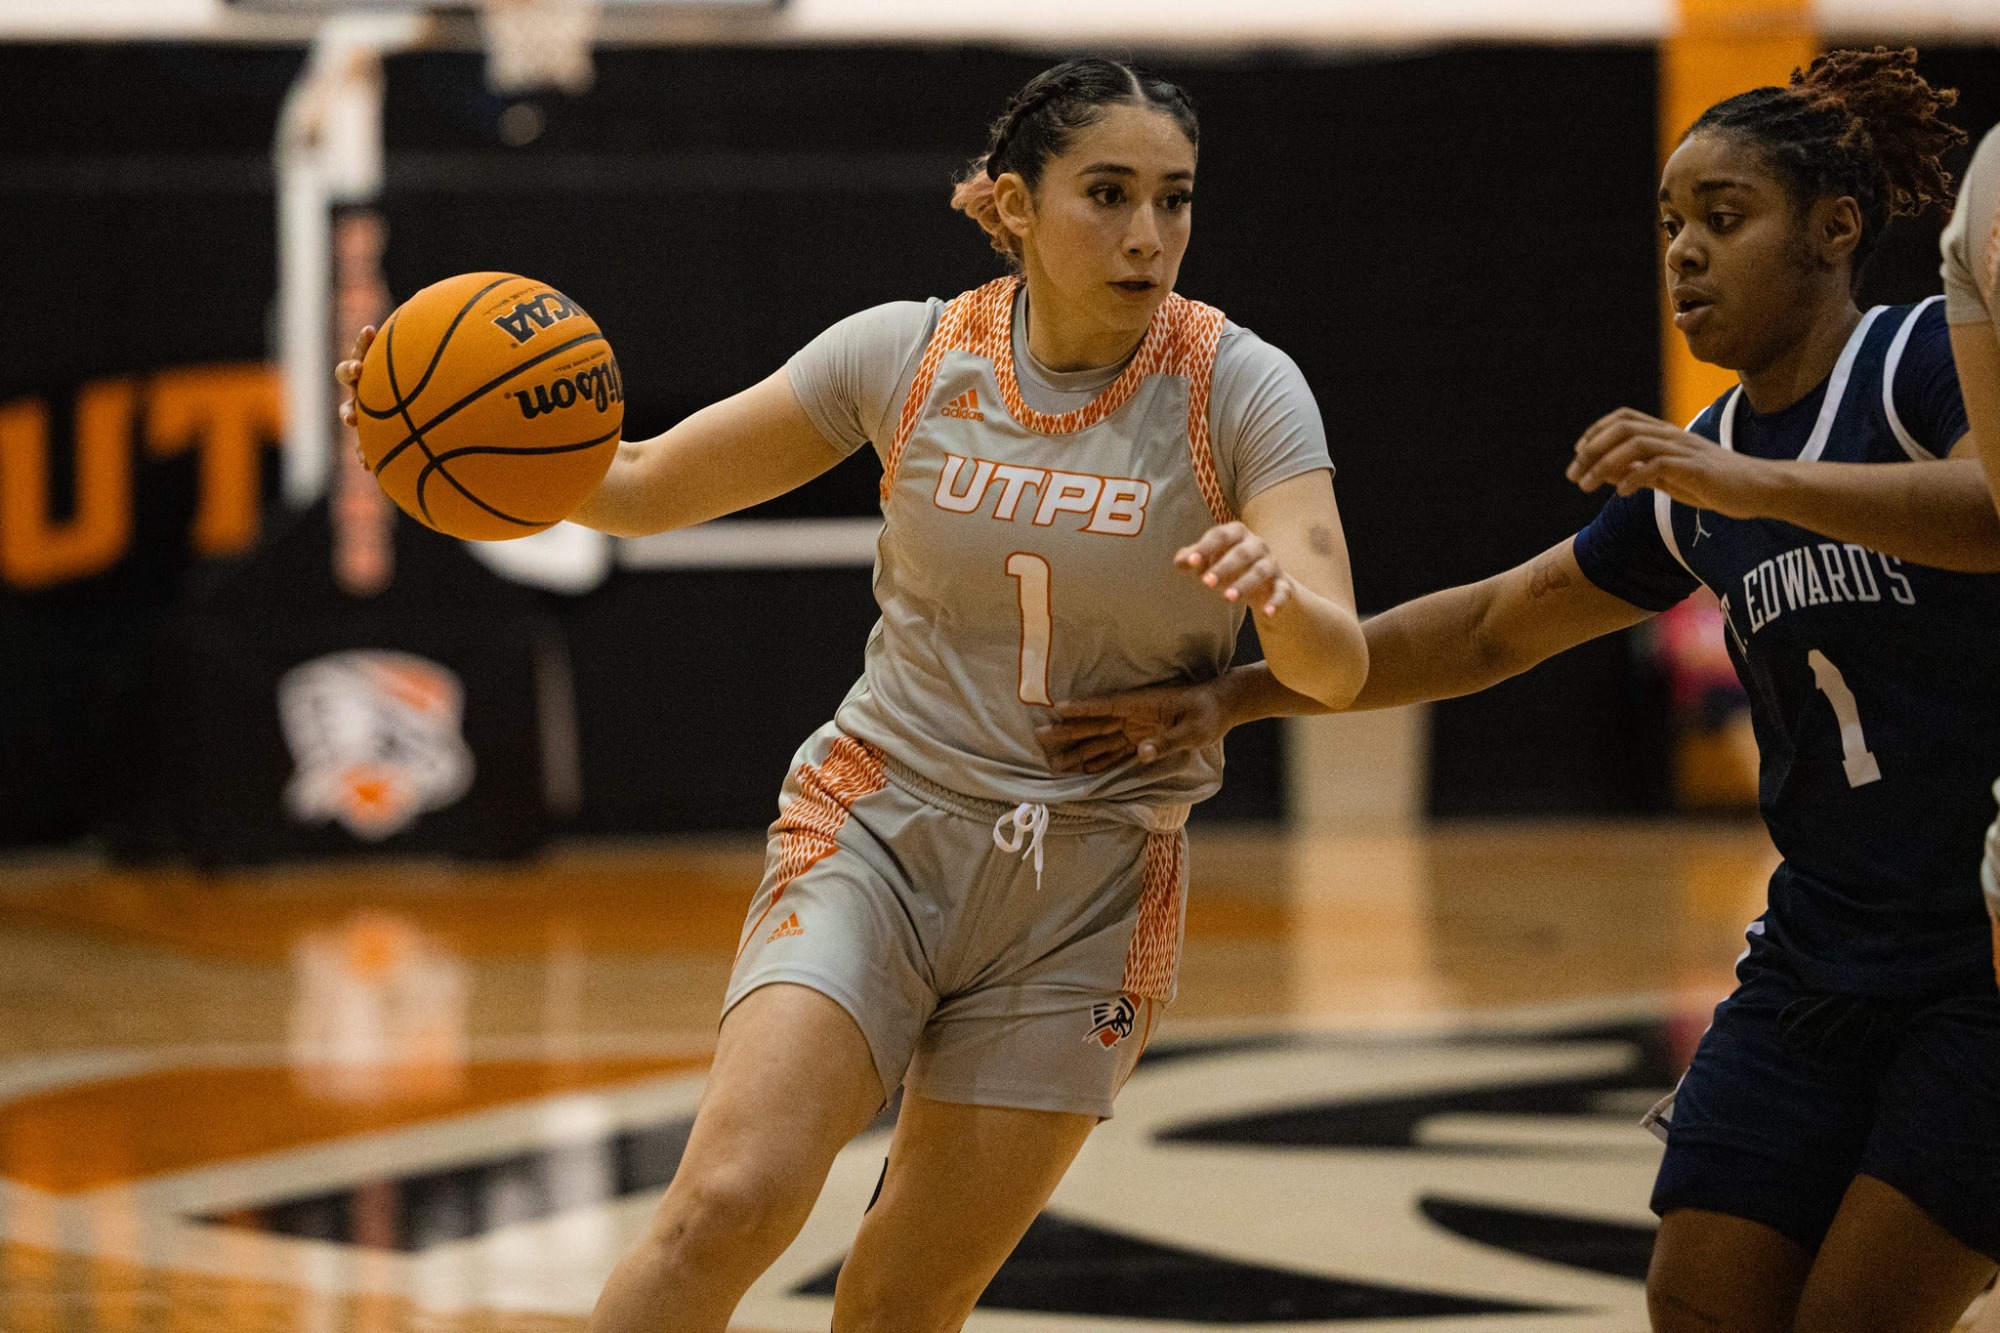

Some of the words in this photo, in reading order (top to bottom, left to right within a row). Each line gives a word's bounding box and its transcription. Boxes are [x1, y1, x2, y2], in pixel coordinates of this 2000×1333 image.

[941, 407, 985, 422] adidas
[933, 452, 1151, 538] UTPB
[1004, 551, 1054, 708] 1
[1808, 649, 1882, 789] 1
